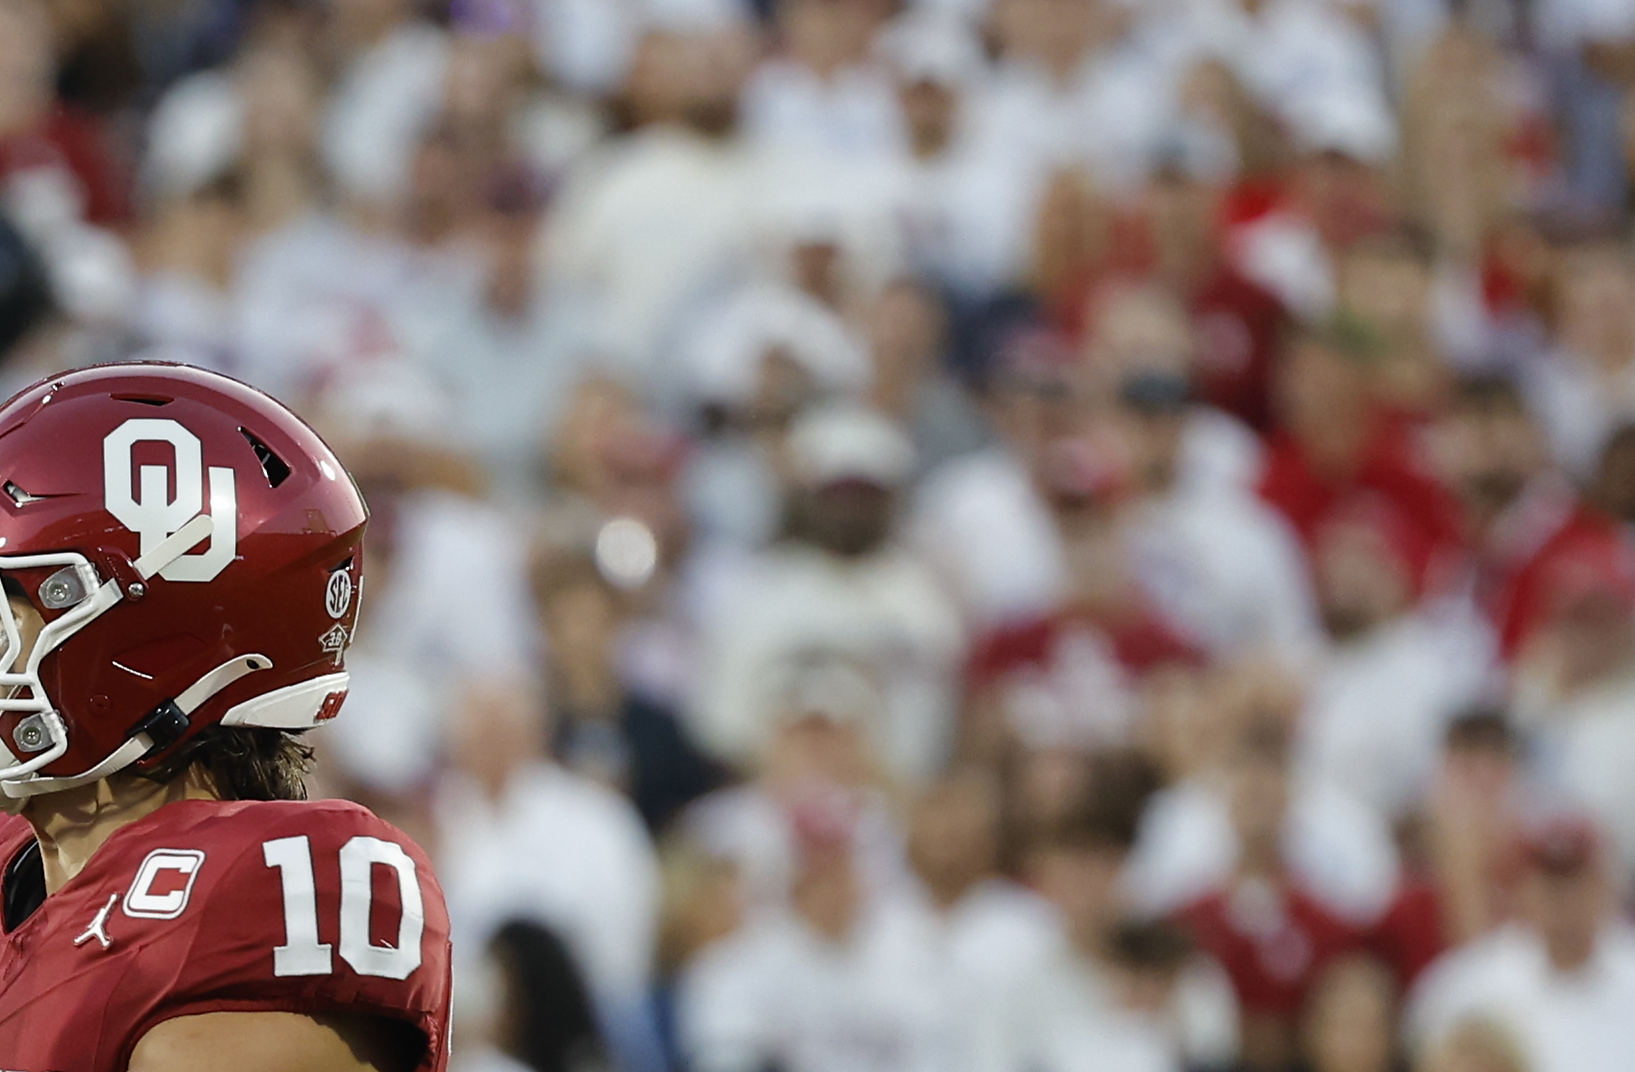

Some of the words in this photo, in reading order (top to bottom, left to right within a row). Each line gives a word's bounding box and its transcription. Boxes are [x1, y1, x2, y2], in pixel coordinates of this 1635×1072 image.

[103, 418, 238, 583] OU
[328, 573, 349, 615] SEC
[129, 856, 197, 912] C
[263, 835, 424, 981] 10
